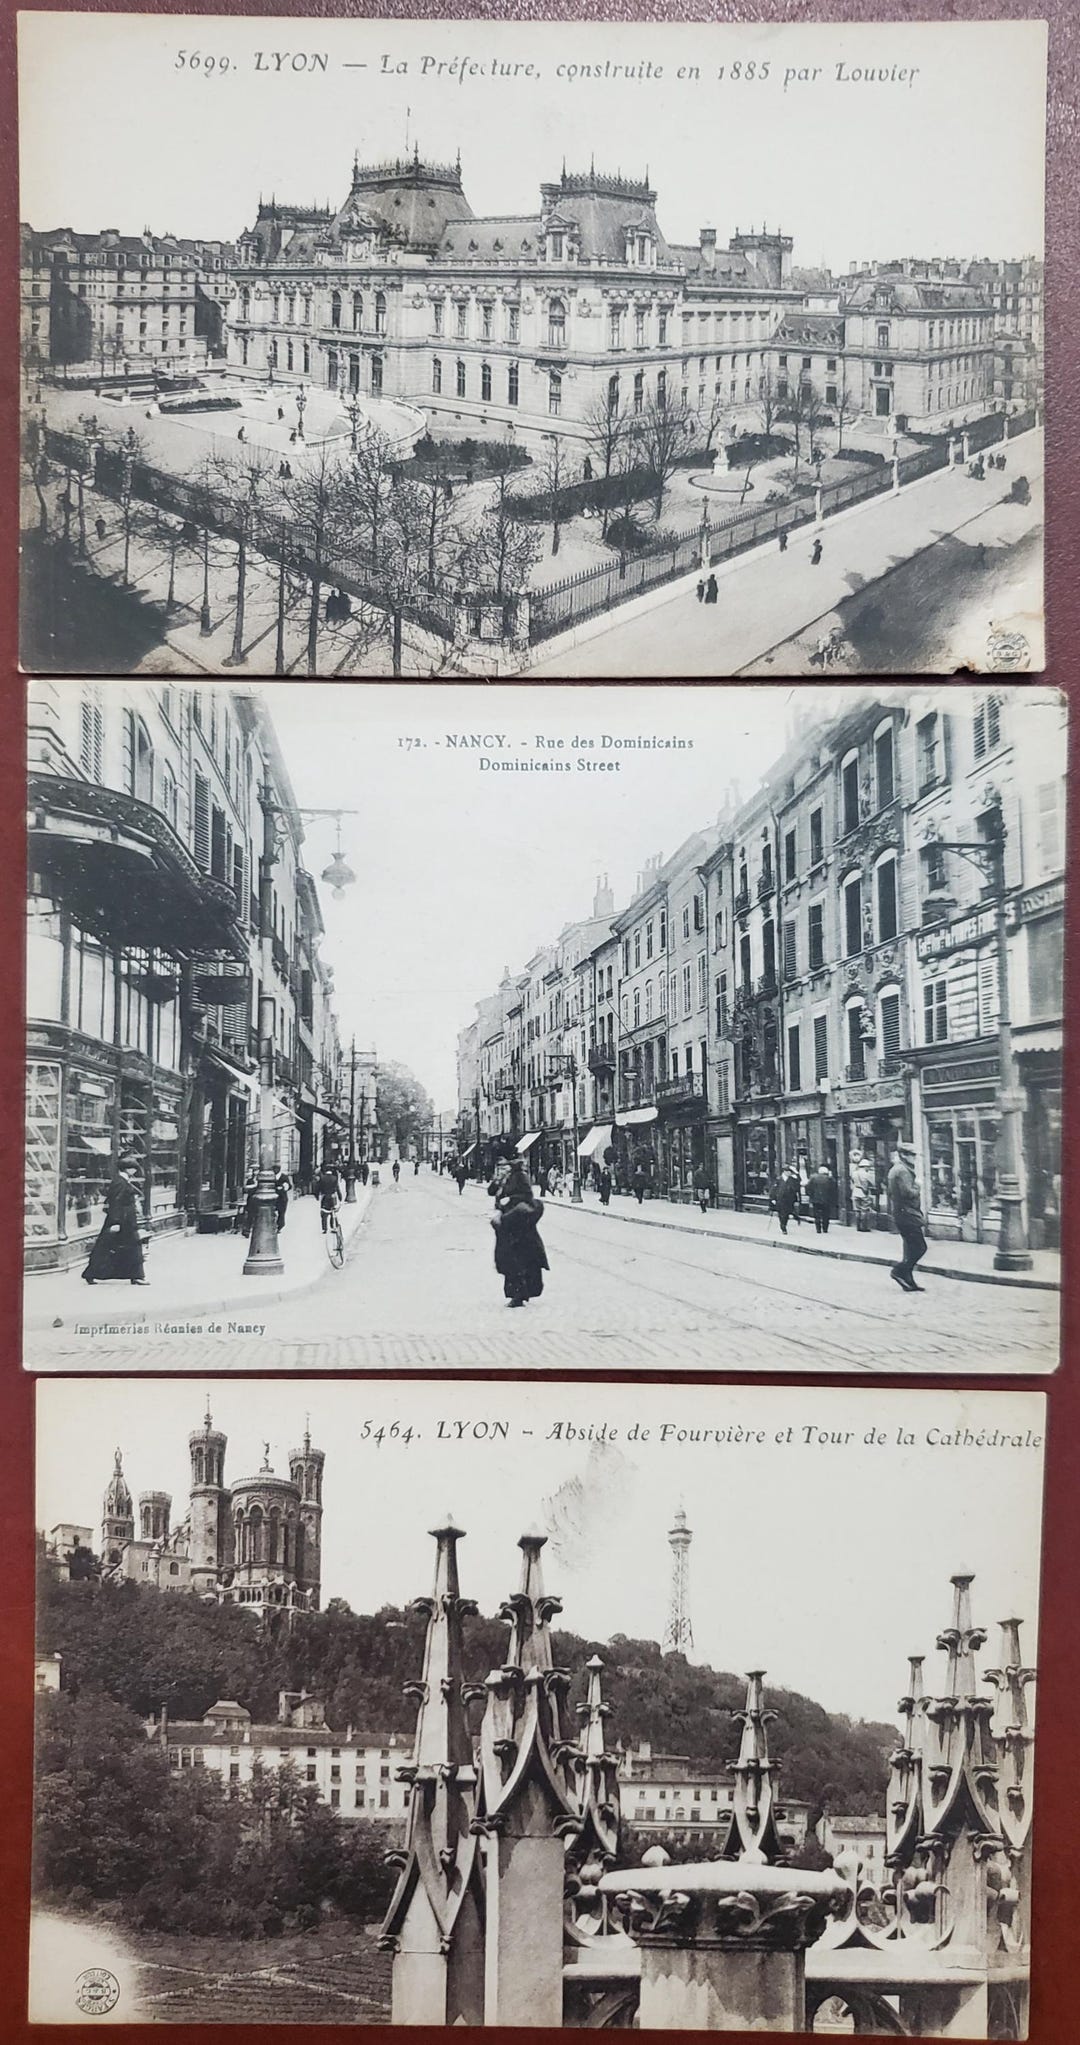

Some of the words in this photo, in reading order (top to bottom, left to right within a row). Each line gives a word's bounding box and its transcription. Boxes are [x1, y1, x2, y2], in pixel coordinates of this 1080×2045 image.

[174, 49, 238, 79] 5699.
[253, 51, 329, 73] LYON
[379, 53, 409, 75] La
[555, 60, 664, 84] construite
[676, 65, 701, 81] en
[717, 60, 771, 81] 1885
[783, 67, 823, 93] par
[835, 61, 921, 89] Louvier
[444, 734, 512, 749] NANCY.
[534, 734, 565, 749] Rue
[570, 734, 595, 749] des
[600, 734, 694, 750] Dominicains
[478, 757, 572, 773] Dominicains
[576, 757, 622, 772] Street
[207, 1321, 223, 1334] de
[226, 1321, 267, 1337] Nancy
[359, 1419, 422, 1450] 5464.
[436, 1420, 510, 1441] LYON
[544, 1421, 619, 1444] Abside
[626, 1422, 651, 1442] de
[659, 1423, 766, 1446] Fourvière
[774, 1426, 795, 1446] et
[801, 1425, 856, 1446] Tour
[863, 1426, 888, 1446] de
[895, 1426, 916, 1446] la
[925, 1425, 1044, 1451] Cathédrale
